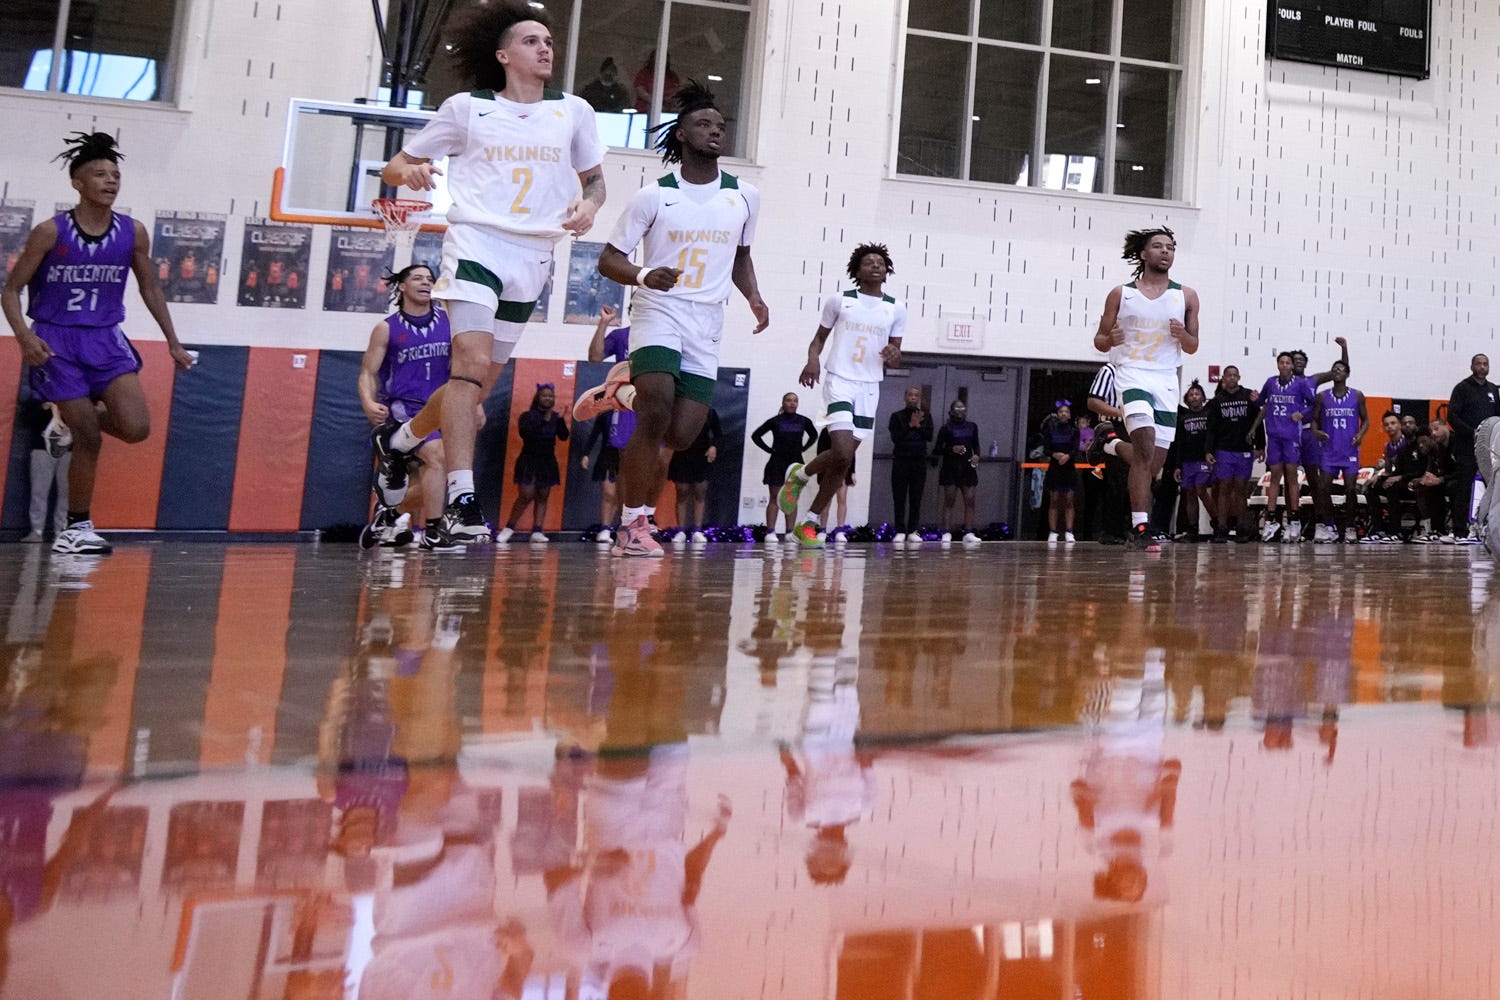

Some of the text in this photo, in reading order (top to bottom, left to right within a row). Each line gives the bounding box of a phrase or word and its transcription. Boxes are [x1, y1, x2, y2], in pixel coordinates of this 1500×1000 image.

[1325, 15, 1377, 32] PLAYER FOUL
[1400, 27, 1423, 39] FOULS
[1336, 53, 1363, 65] MATCH
[484, 145, 561, 163] VIKINGS
[510, 168, 533, 213] 2
[668, 229, 730, 243] VIKINGS
[675, 248, 708, 288] 15
[66, 288, 99, 311] 21
[953, 324, 972, 338] EXIT
[852, 336, 868, 363] 5
[1129, 332, 1164, 361] 22
[425, 362, 431, 381] 1
[1273, 405, 1287, 416] 22
[1333, 418, 1347, 429] 44
